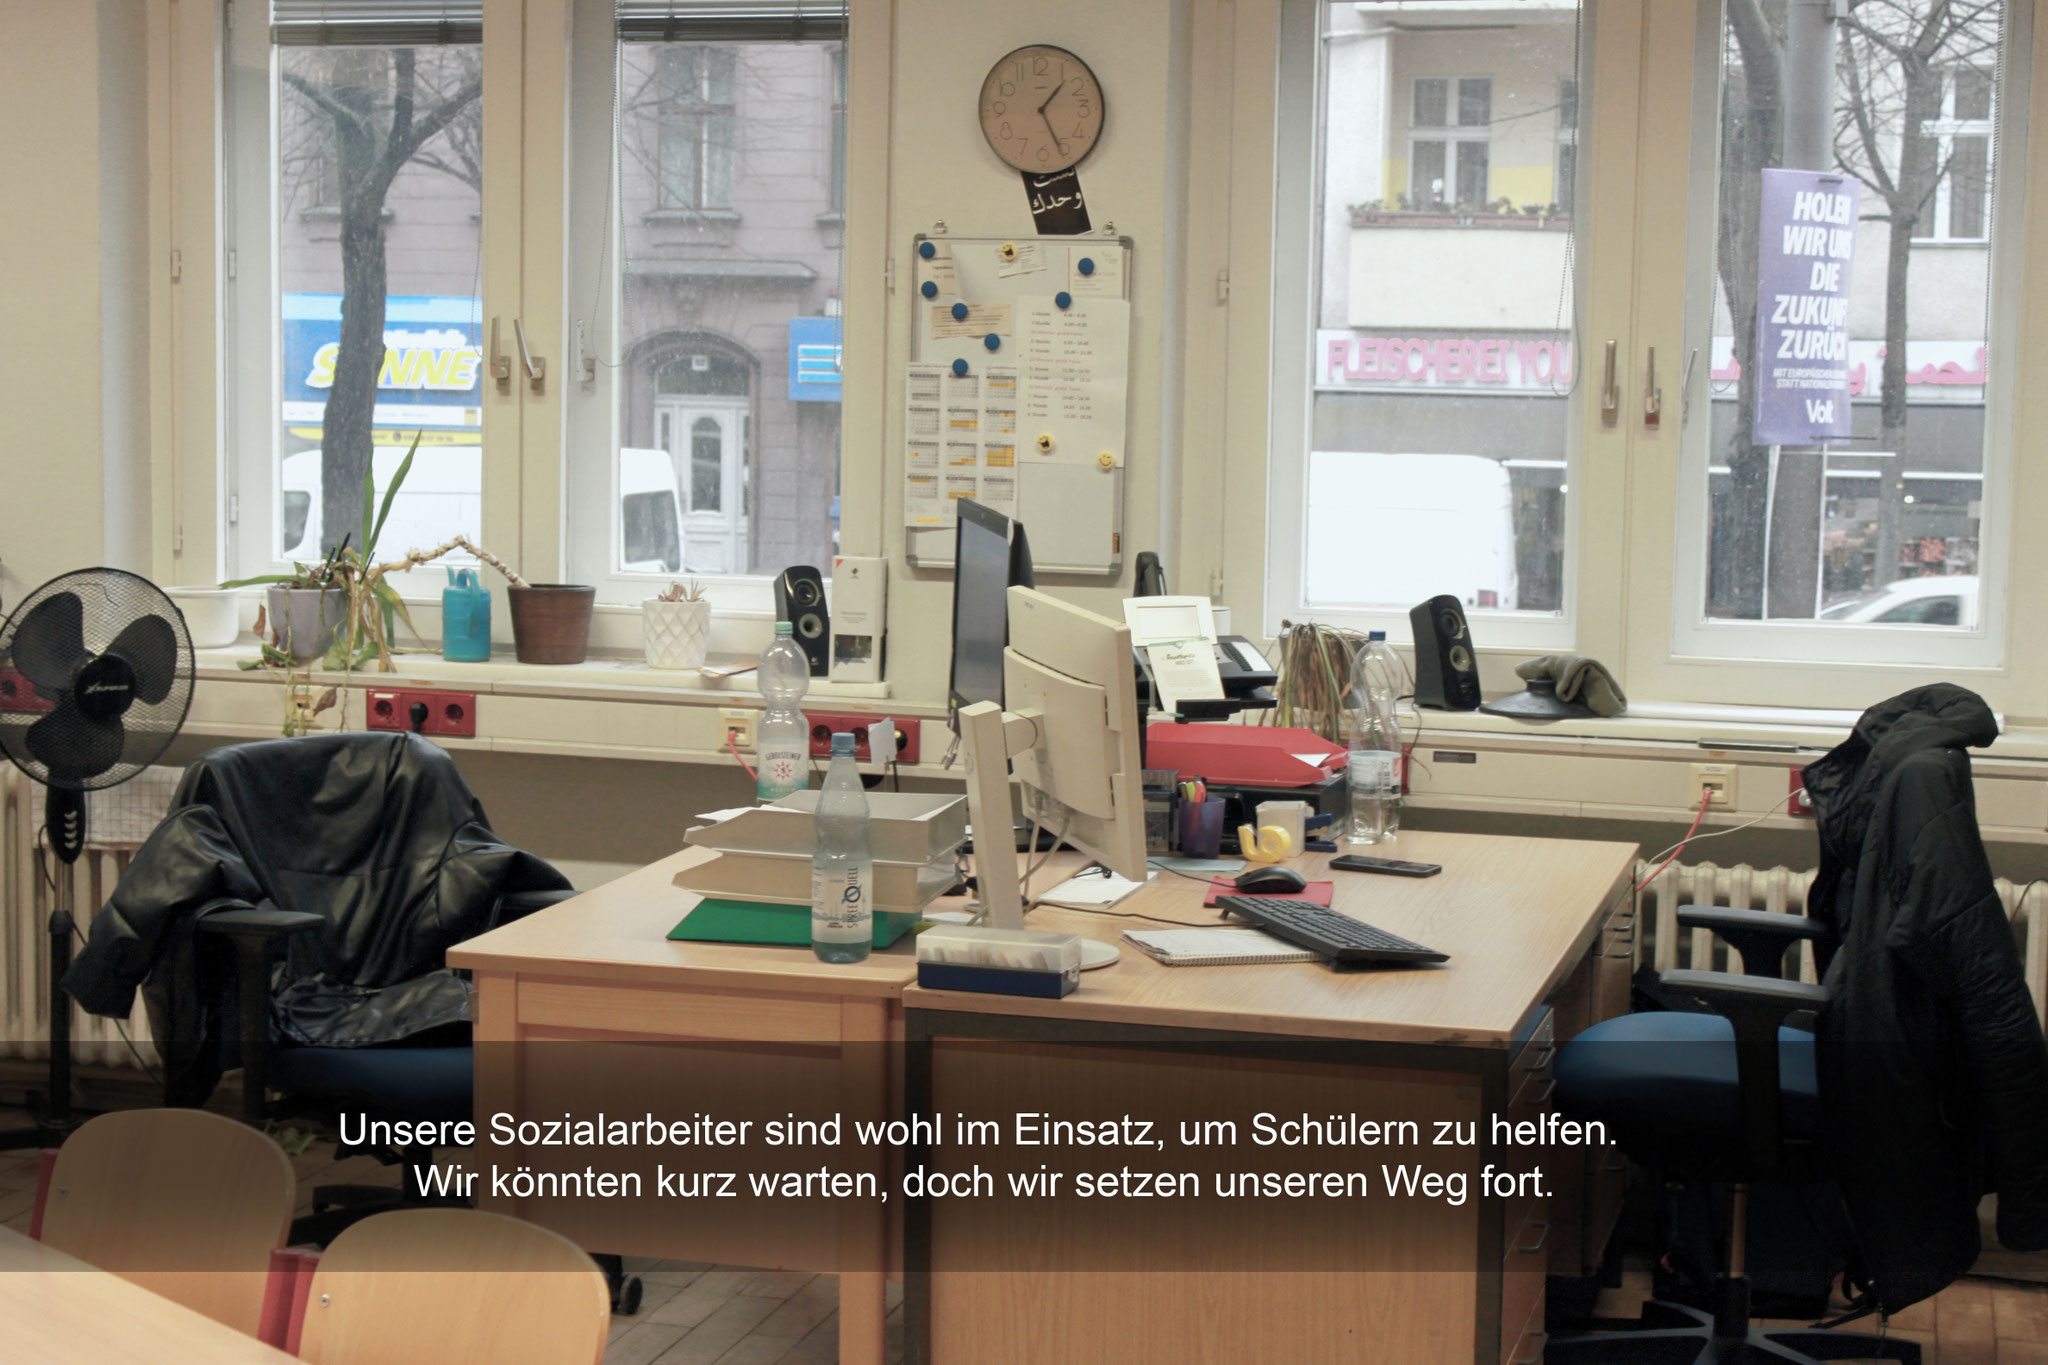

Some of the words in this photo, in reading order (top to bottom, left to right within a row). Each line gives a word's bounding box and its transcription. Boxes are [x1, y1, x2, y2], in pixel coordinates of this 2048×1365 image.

[1016, 62, 1025, 82] 11
[1033, 57, 1049, 76] 12
[1071, 77, 1085, 96] 2
[993, 101, 1006, 117] 9
[1077, 100, 1090, 118] 3
[1001, 122, 1013, 140] 8
[1071, 122, 1085, 138] 4
[1017, 138, 1029, 156] 7
[1036, 144, 1050, 162] 6
[1058, 137, 1071, 156] 5
[1783, 225, 1828, 257] WIR
[1809, 262, 1841, 292] DIE
[1771, 295, 1848, 327] ZUKUNF
[309, 346, 480, 387] SNNE
[1328, 338, 1511, 382] FLEISCHEREI
[1806, 399, 1834, 424] Volt
